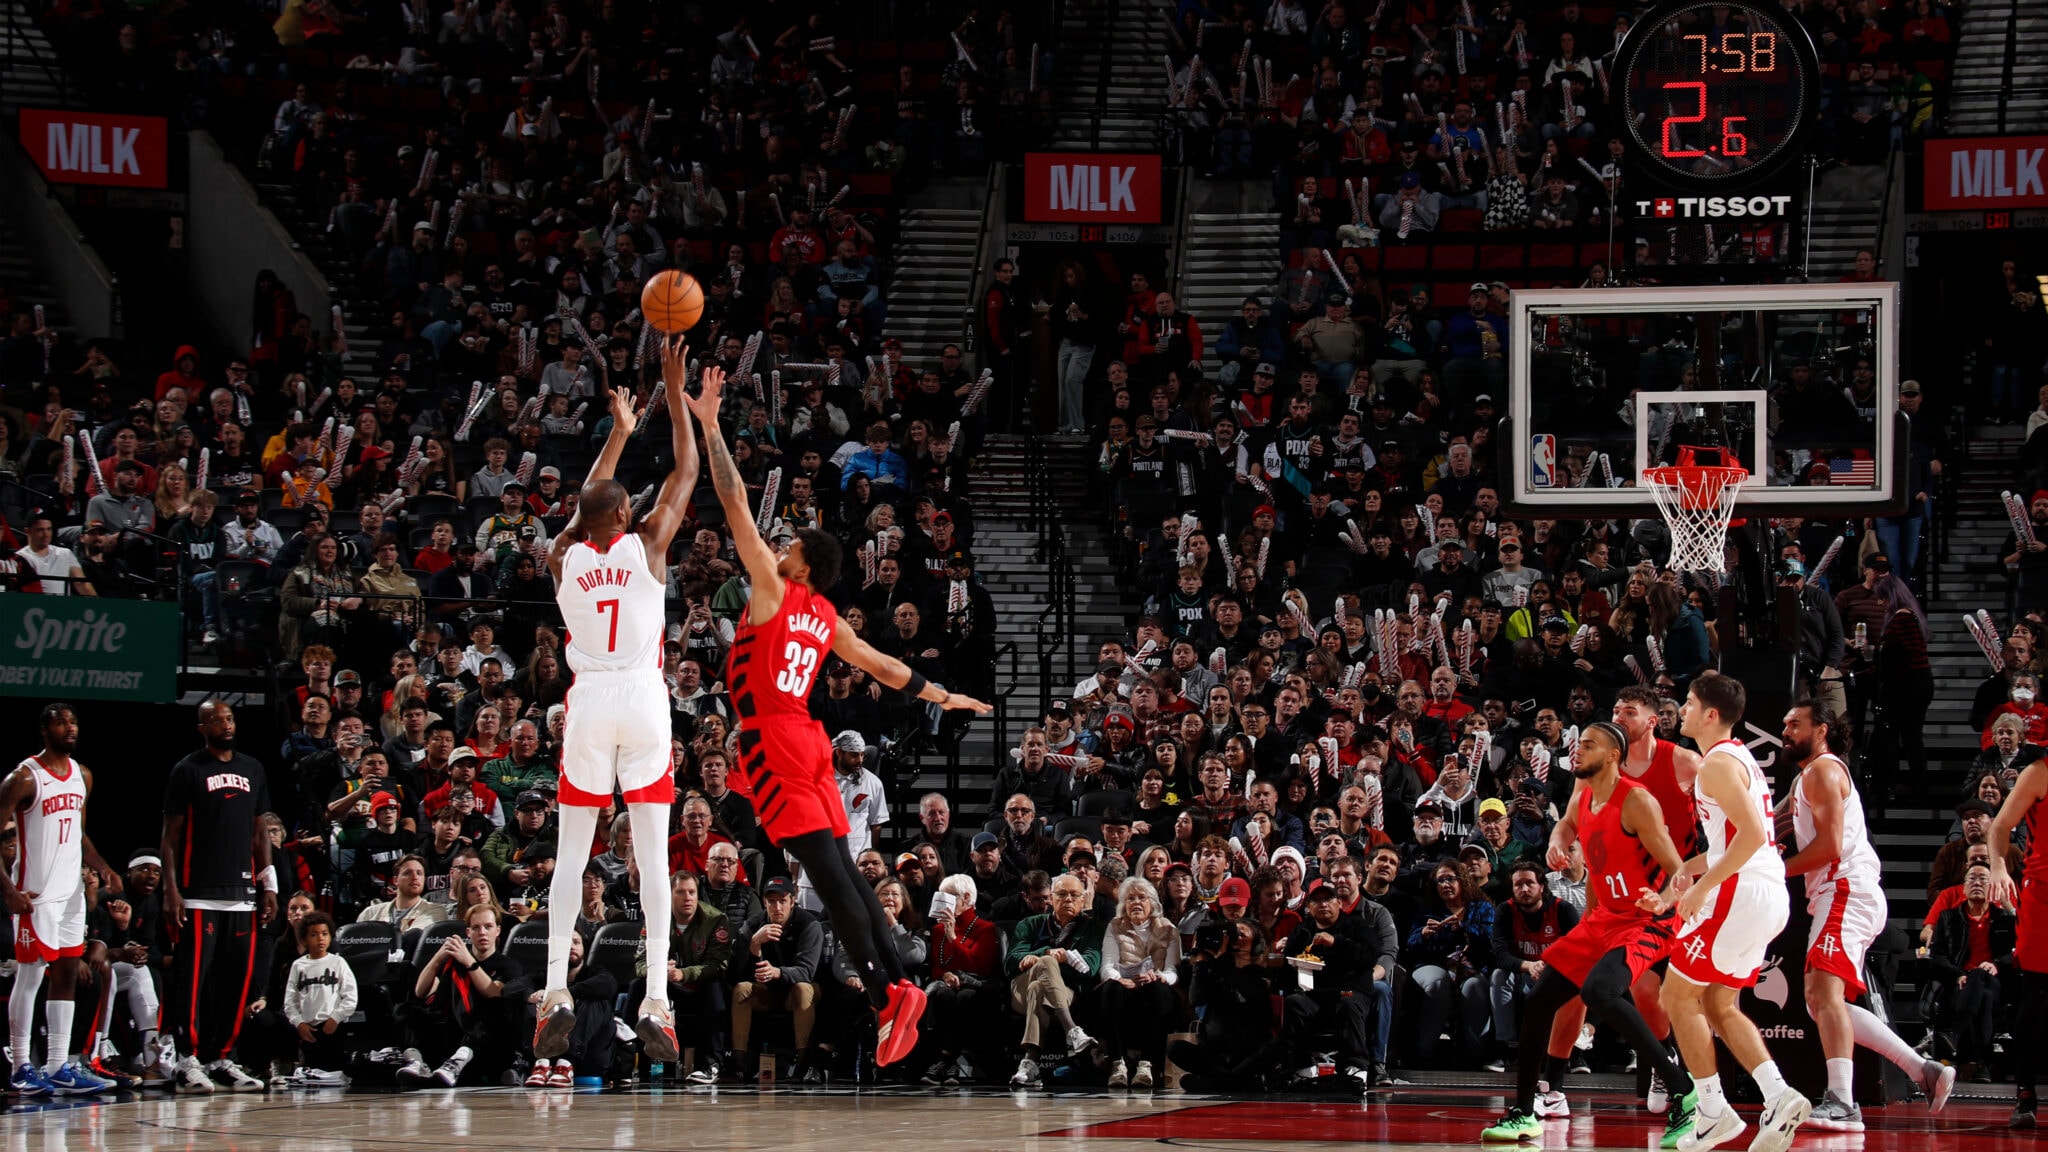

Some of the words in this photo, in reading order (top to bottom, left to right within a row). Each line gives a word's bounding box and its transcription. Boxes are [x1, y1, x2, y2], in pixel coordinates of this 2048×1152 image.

[1683, 32, 1776, 74] 7:58
[1661, 81, 1748, 158] 2.6
[47, 121, 142, 176] MLK
[1950, 149, 2046, 198] MLK
[1050, 164, 1136, 212] MLK
[1677, 196, 1791, 218] TISSOT
[1049, 231, 1068, 241] 105
[1117, 232, 1136, 242] 106
[1286, 439, 1310, 456] PDX
[1132, 461, 1164, 472] PORTLAND
[576, 567, 633, 593] DURANT
[596, 598, 620, 653] 7
[1179, 606, 1203, 621] PDX
[14, 607, 128, 660] Sprite
[787, 612, 831, 645] CAMARA
[0, 664, 39, 686] OBEY
[38, 667, 84, 688] YOUR
[86, 669, 144, 690] THIRST
[776, 640, 818, 698] 33
[207, 773, 251, 793] ROCKETS
[42, 793, 83, 817] ROCKETS
[59, 818, 72, 844] 17
[1605, 872, 1630, 899] 21
[341, 936, 393, 945] ticketmaster
[513, 936, 548, 945] ticketma
[599, 937, 640, 946] ticketmas
